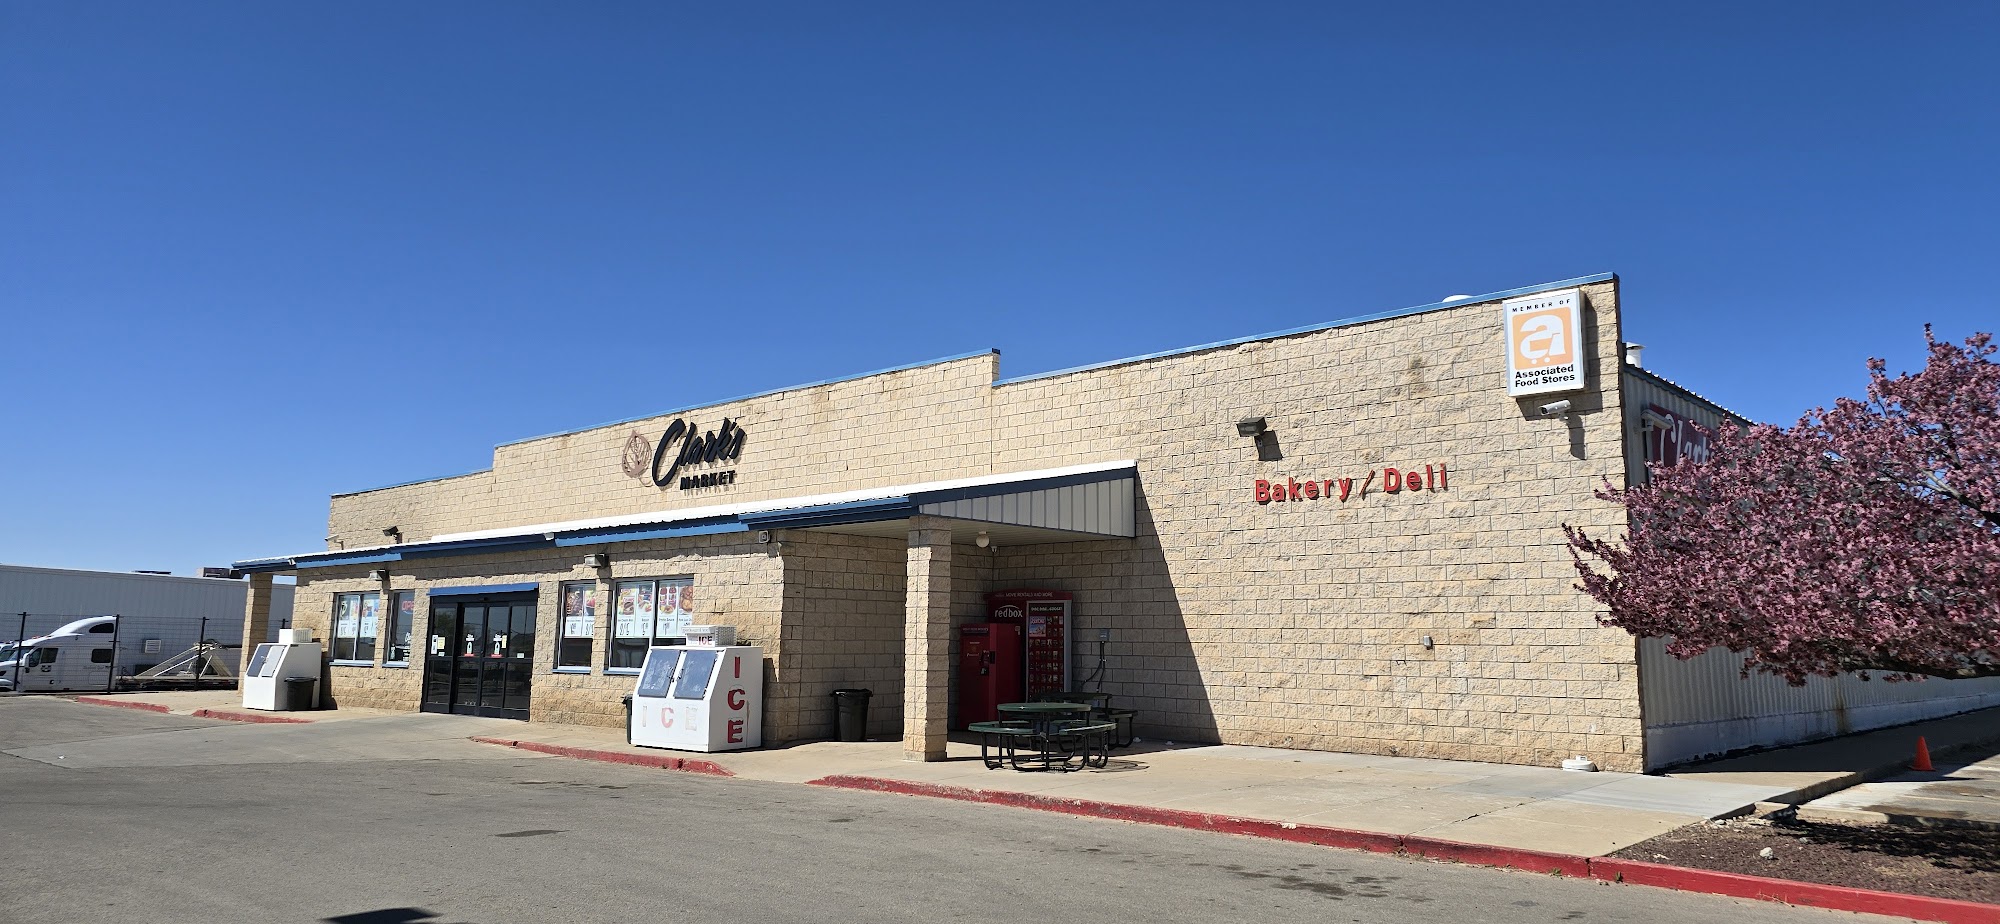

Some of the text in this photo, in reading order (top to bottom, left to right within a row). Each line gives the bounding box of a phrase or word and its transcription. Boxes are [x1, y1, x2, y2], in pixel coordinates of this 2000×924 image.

[1512, 302, 1553, 312] MEMBER
[1515, 364, 1574, 379] Associated
[1515, 374, 1575, 388] Food Stores
[652, 417, 746, 487] Clark's
[680, 470, 736, 490] MARKET
[402, 600, 415, 611] OPE
[994, 607, 1023, 618] redbox
[698, 635, 713, 646] ICE
[727, 656, 746, 743] ICE
[642, 704, 698, 732] ICE
